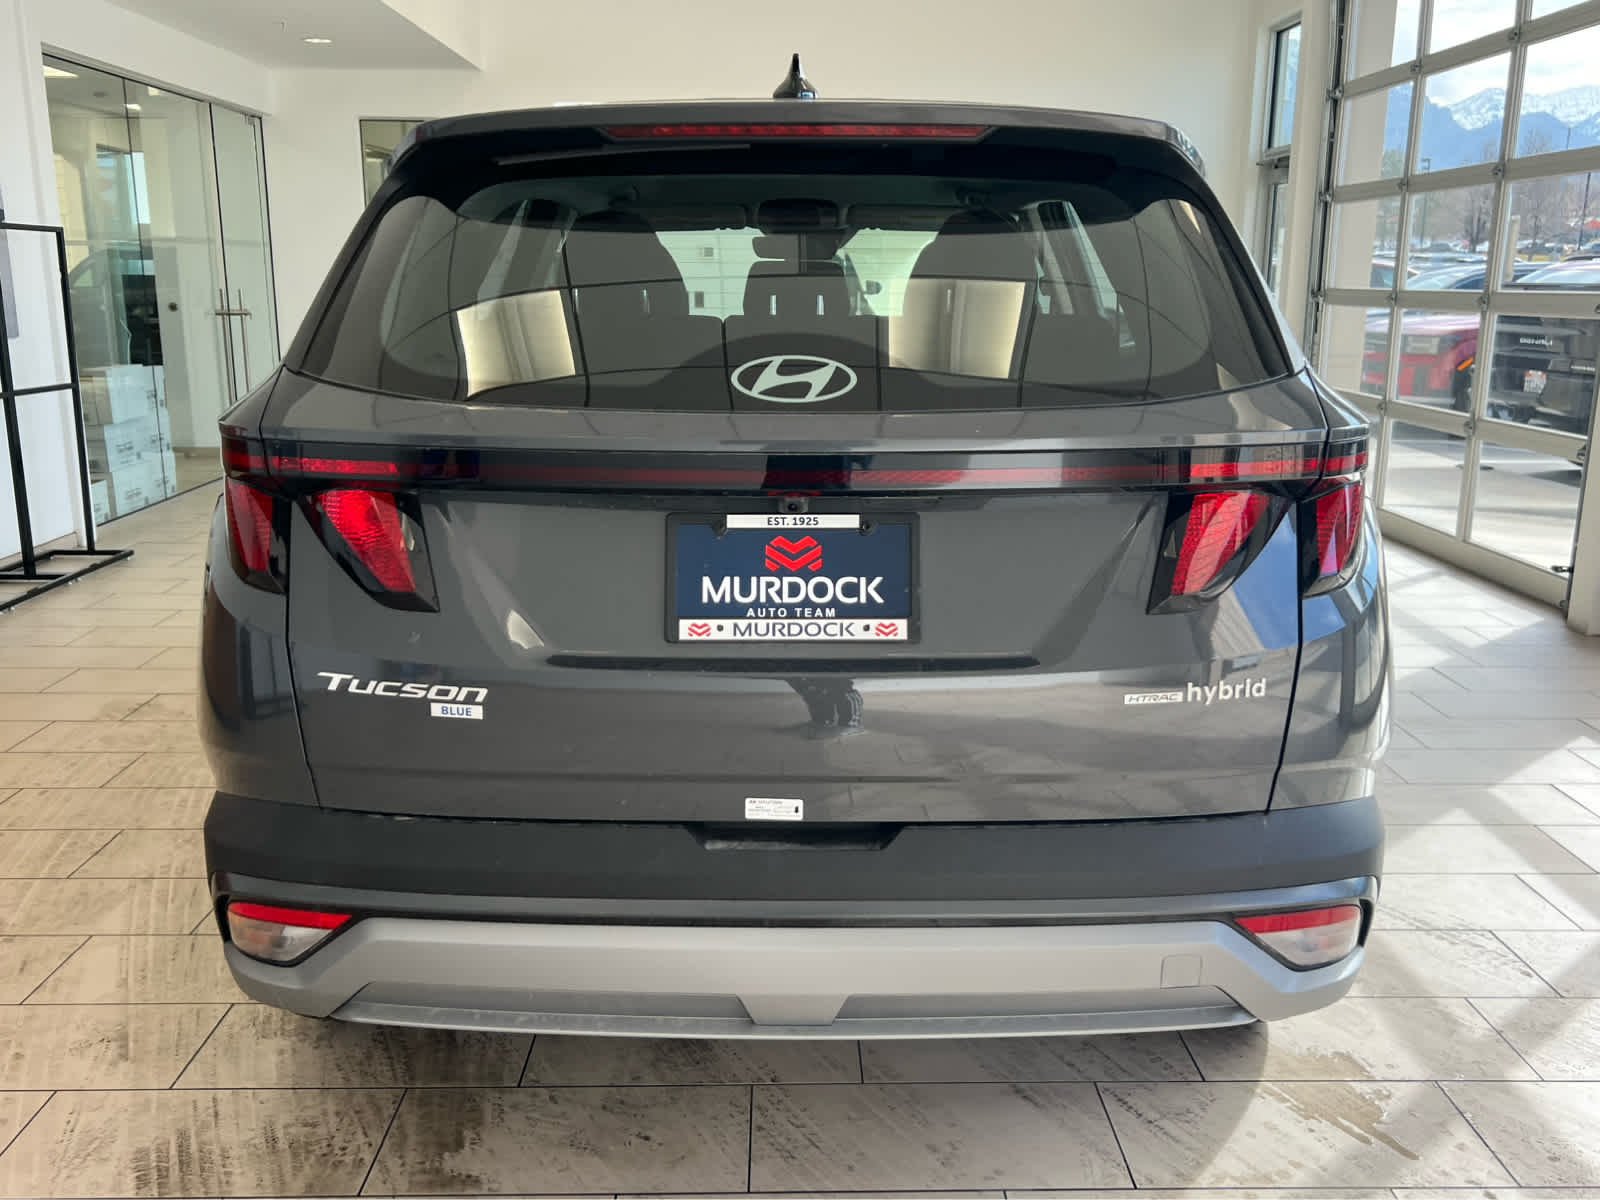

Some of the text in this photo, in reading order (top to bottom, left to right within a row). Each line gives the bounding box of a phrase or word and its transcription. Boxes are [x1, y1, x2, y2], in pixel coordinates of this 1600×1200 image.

[767, 516, 819, 526] EST. 1925
[702, 576, 885, 604] MURDOCK
[746, 607, 836, 618] AUTO TEAM
[732, 622, 856, 637] MURDOCK
[1187, 677, 1267, 706] hybrid
[440, 705, 473, 717] BLUE
